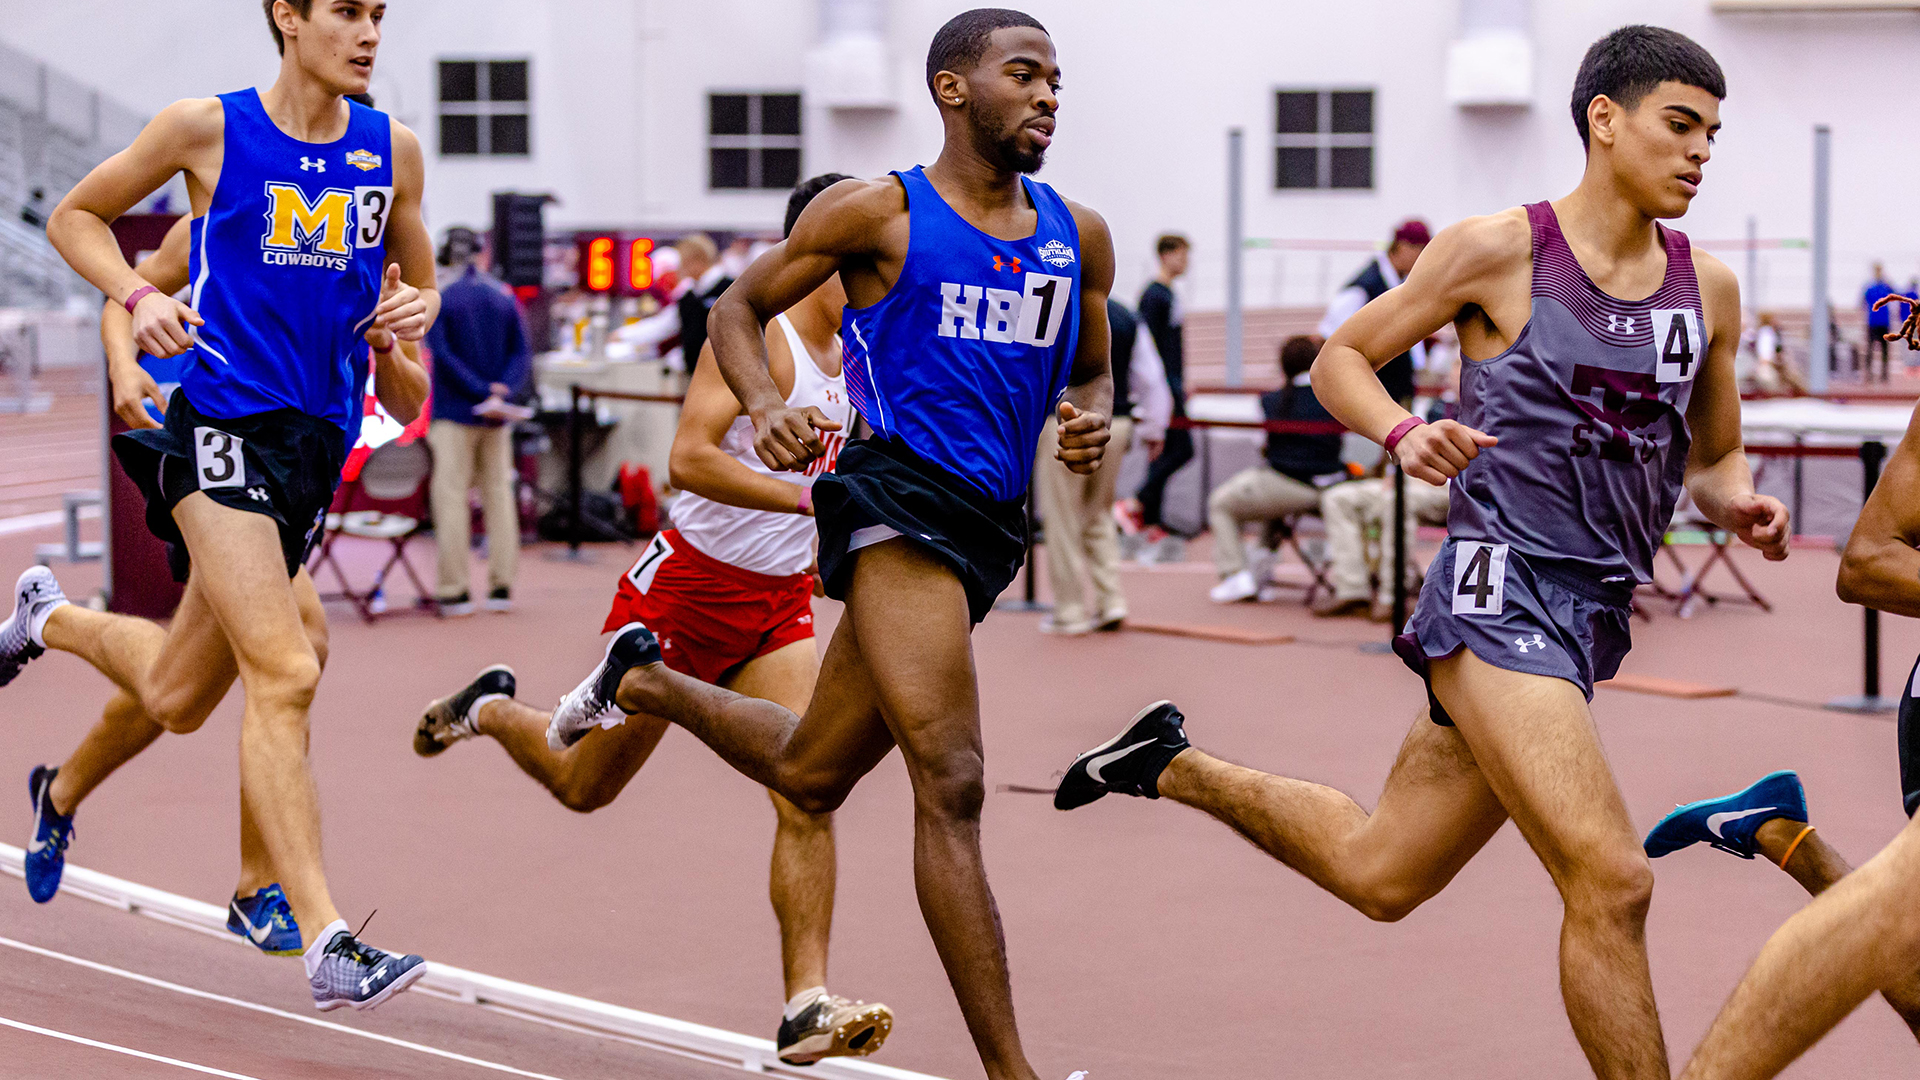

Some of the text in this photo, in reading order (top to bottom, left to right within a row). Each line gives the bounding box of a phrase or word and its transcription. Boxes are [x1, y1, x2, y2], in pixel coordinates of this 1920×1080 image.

[261, 181, 355, 259] M
[362, 190, 387, 243] 3
[263, 251, 348, 271] COWBOYS
[938, 282, 1024, 344] HB
[1032, 280, 1057, 340] 1
[1662, 313, 1694, 377] 4
[203, 431, 236, 482] 3
[633, 538, 667, 580] 7
[1457, 546, 1495, 608] 4
